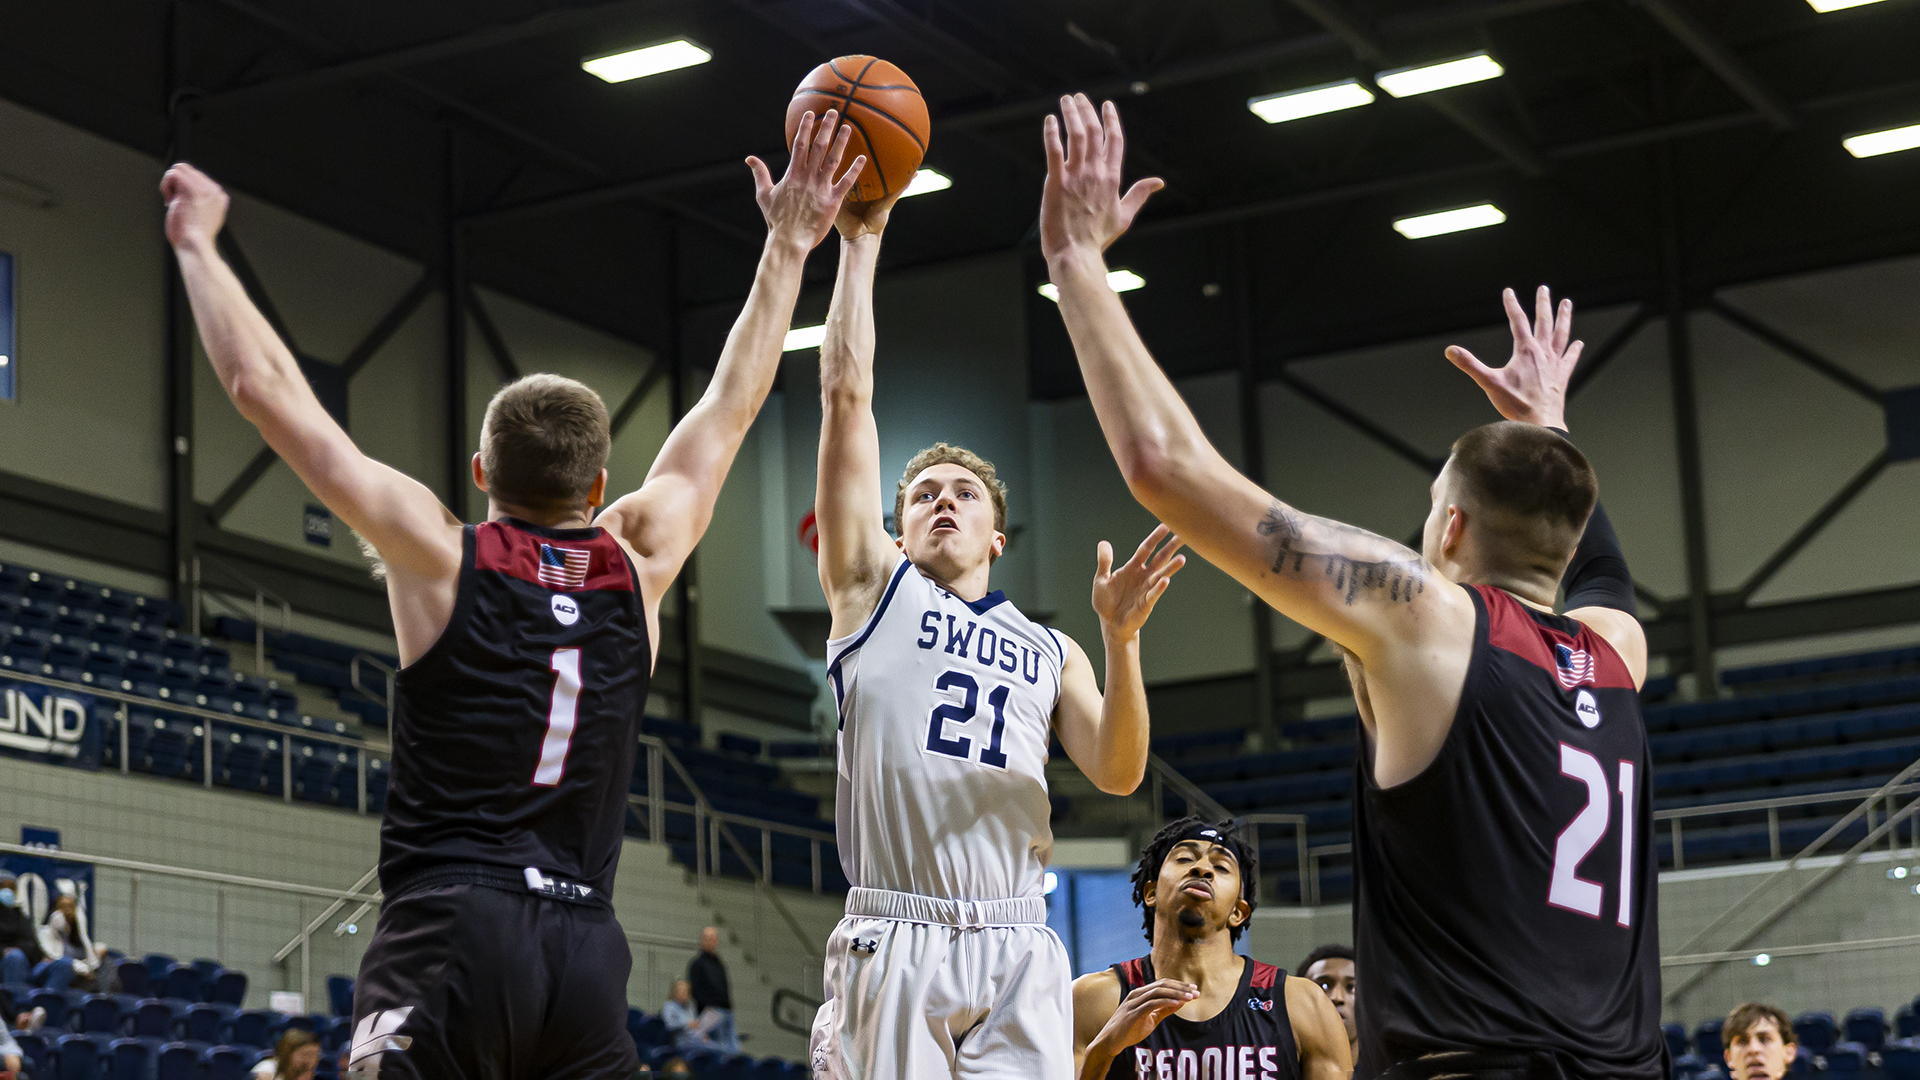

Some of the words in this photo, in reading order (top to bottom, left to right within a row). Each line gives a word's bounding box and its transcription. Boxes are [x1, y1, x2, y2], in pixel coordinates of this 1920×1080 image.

[917, 610, 1041, 686] SWOSU
[531, 647, 582, 787] 1
[925, 669, 1010, 770] 21
[1547, 741, 1634, 929] 21
[1134, 1045, 1279, 1080] REDDIES
